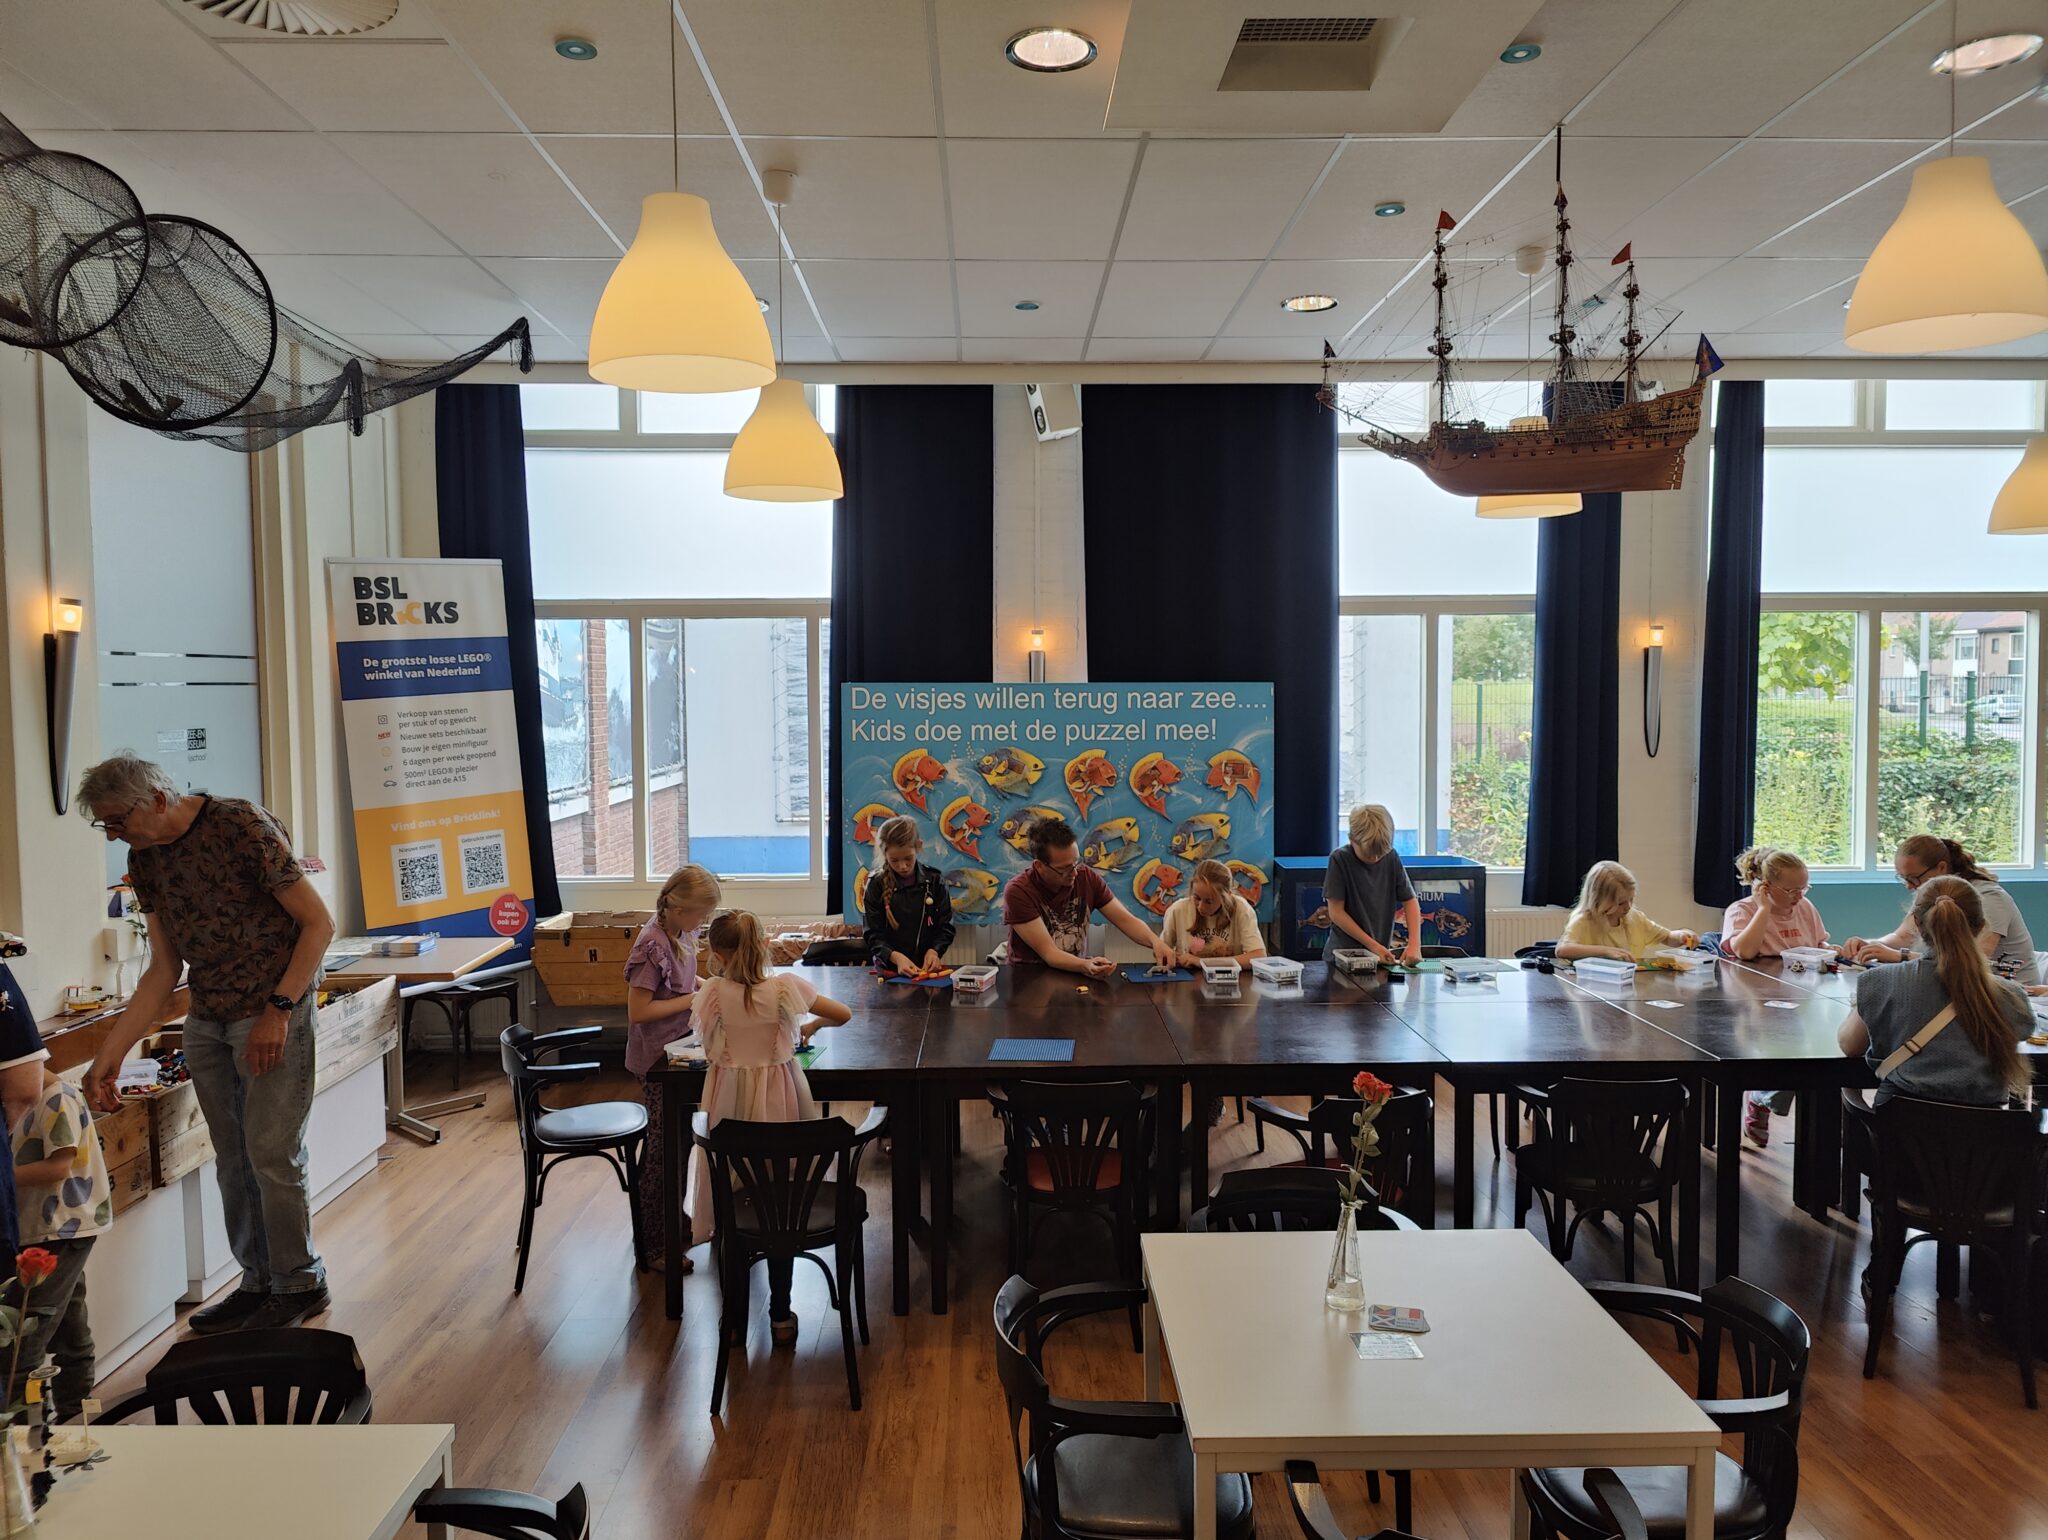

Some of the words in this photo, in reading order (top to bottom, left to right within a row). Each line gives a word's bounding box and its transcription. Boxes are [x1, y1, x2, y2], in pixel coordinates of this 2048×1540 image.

[353, 576, 408, 600] BSL
[363, 658, 378, 668] De
[382, 656, 427, 668] grootste
[429, 655, 456, 665] losse
[364, 670, 402, 680] winkel
[404, 670, 424, 678] van
[427, 666, 480, 678] Nederland
[851, 687, 887, 710] De
[895, 688, 967, 715] visjes
[974, 687, 1045, 709] willen
[1054, 688, 1118, 714] terug
[1127, 691, 1184, 709] naar
[397, 710, 428, 718] Verkoop
[450, 716, 478, 726] gewicht
[445, 728, 488, 736] beschikbaar
[851, 719, 906, 742] Kids
[914, 719, 962, 742] doe
[971, 720, 1018, 742] met
[1026, 719, 1057, 742] de
[1066, 718, 1146, 746] puzzel
[1156, 718, 1217, 741] mee!
[422, 745, 430, 753] je
[431, 743, 452, 752] eigen
[452, 740, 488, 749] minifiguur
[409, 757, 431, 766] dagen
[432, 756, 444, 764] per
[446, 753, 465, 761] week
[466, 750, 496, 761] geopend
[456, 764, 478, 774] plezier
[406, 780, 426, 788] direct
[391, 820, 416, 832] Vind
[418, 819, 437, 828] ons
[439, 817, 452, 826] op
[1416, 891, 1444, 902] RIUM
[498, 910, 520, 918] kopen
